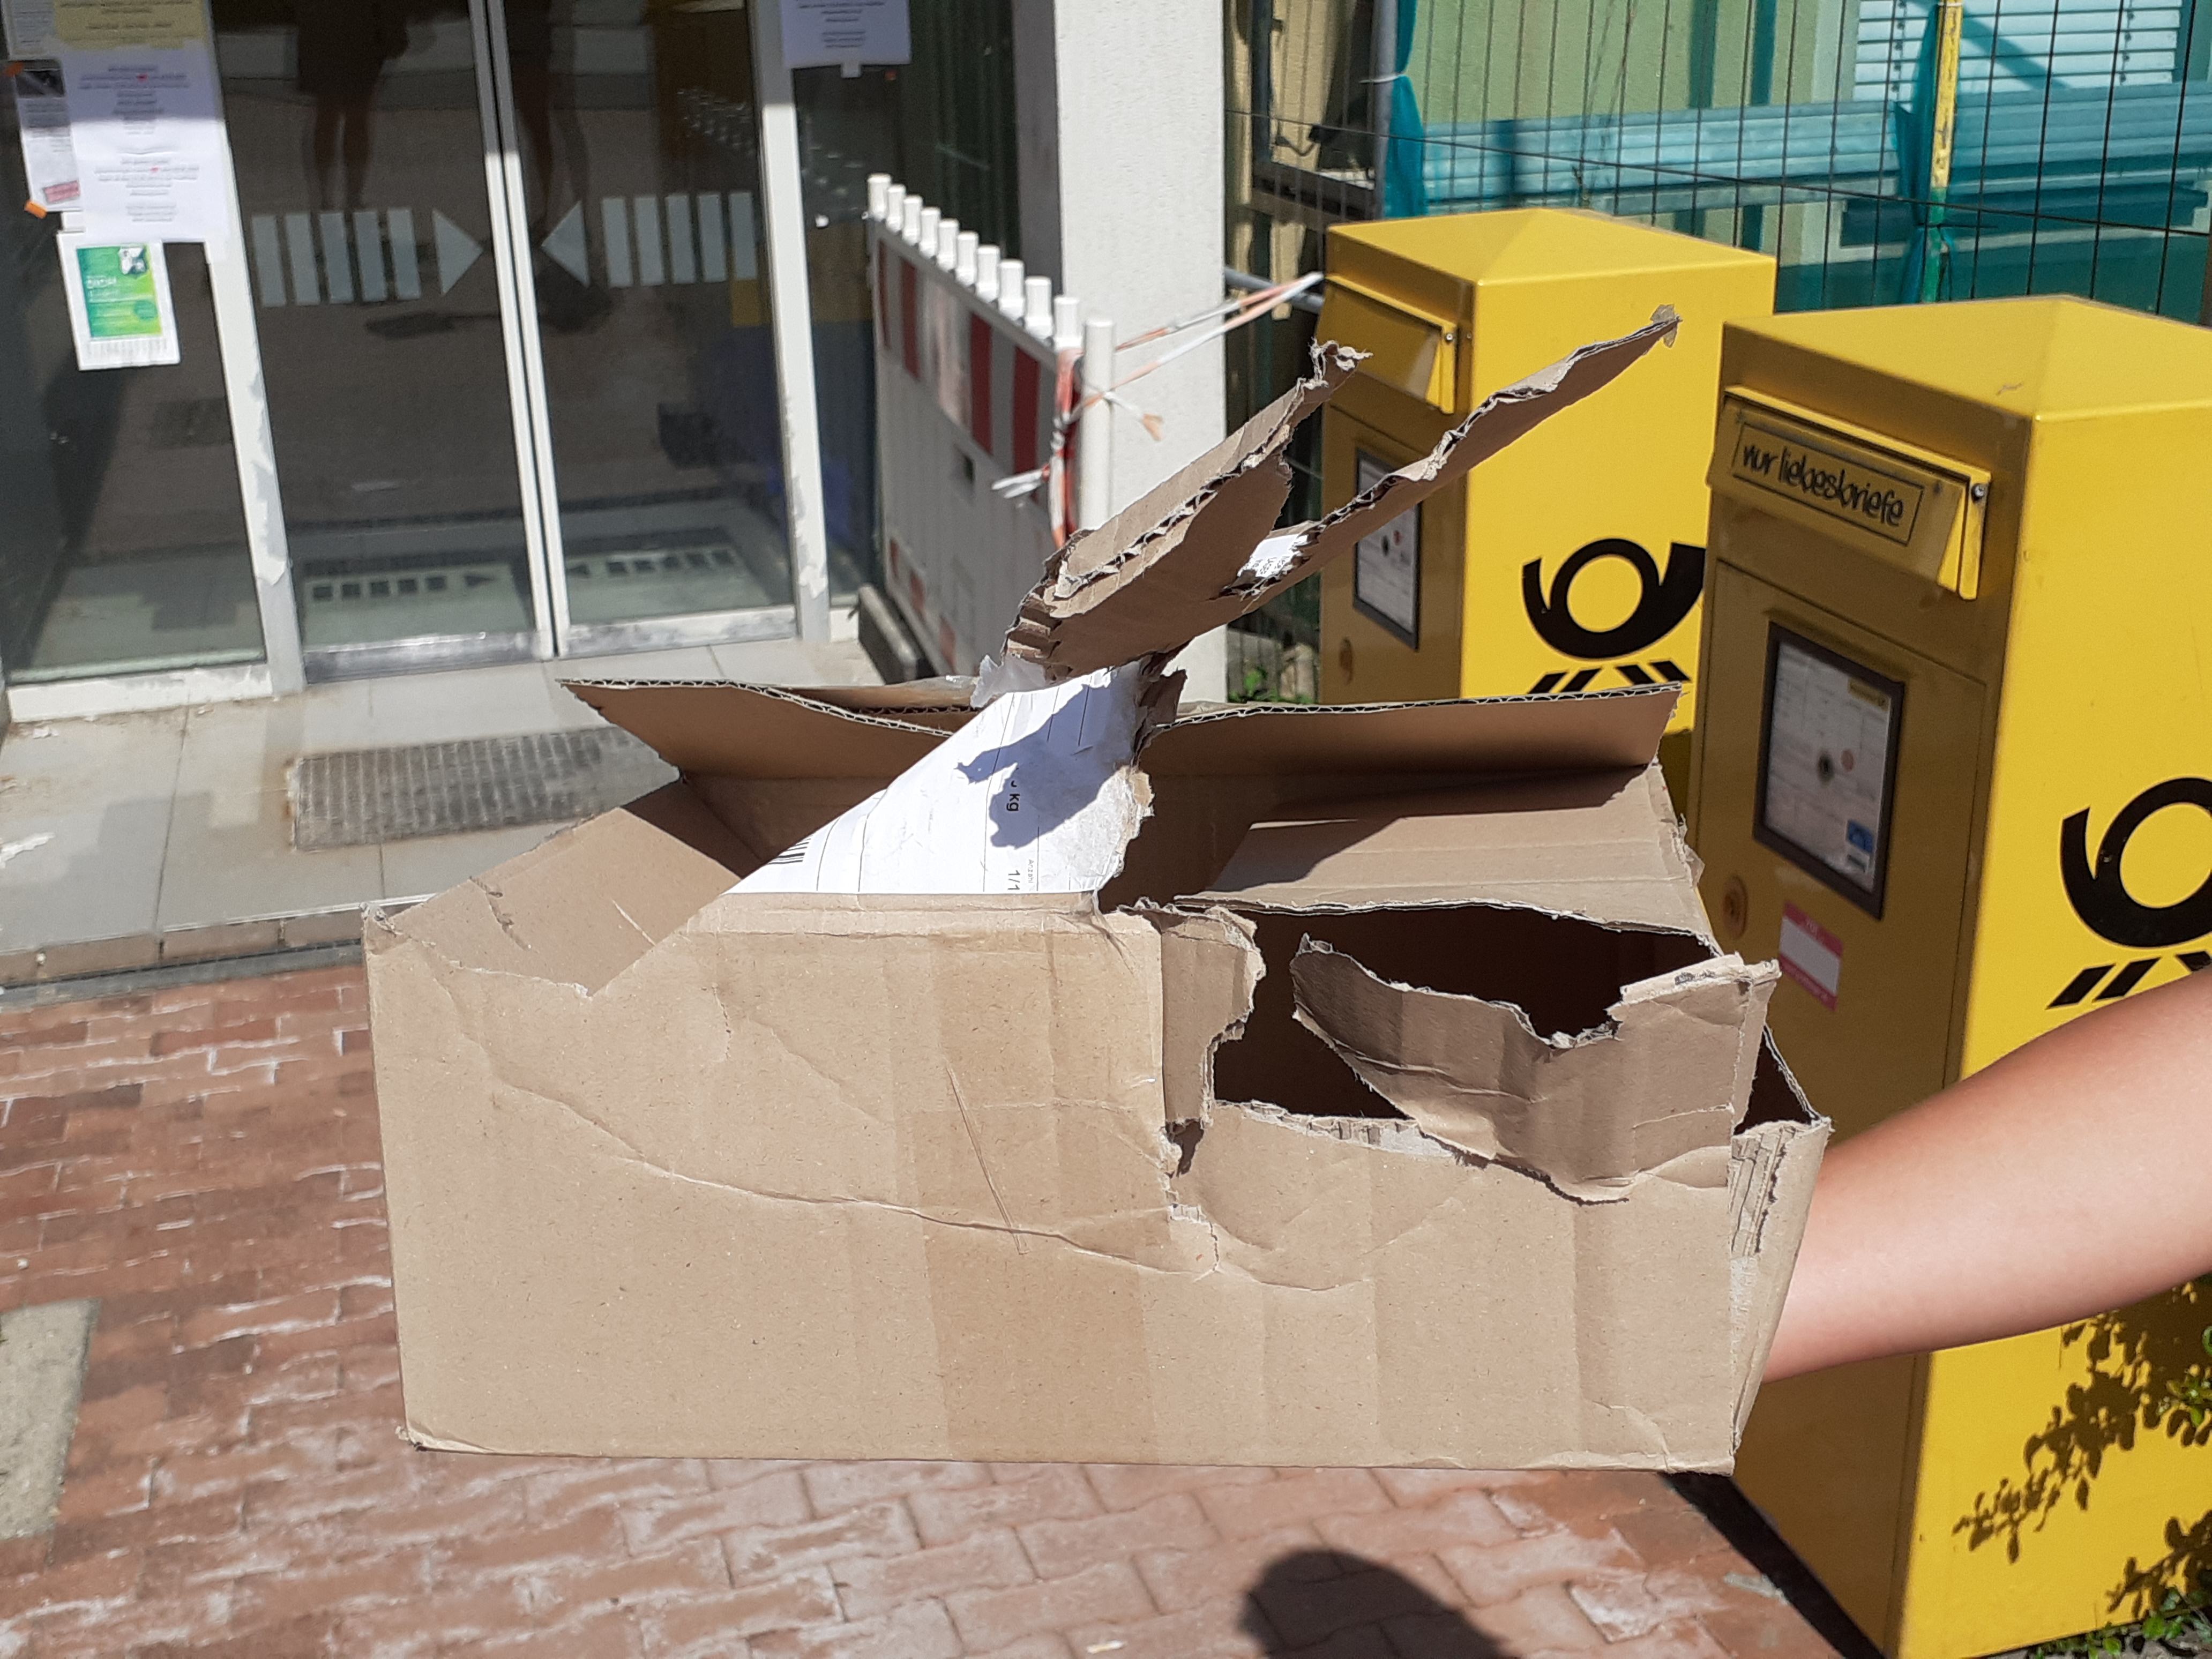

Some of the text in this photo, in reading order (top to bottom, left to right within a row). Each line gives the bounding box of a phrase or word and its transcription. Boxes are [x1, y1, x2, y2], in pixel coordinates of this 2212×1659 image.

[1744, 445, 1904, 527] nur liebesbriefe
[1006, 794, 1021, 811] kg
[1007, 870, 1021, 890] 1/1
